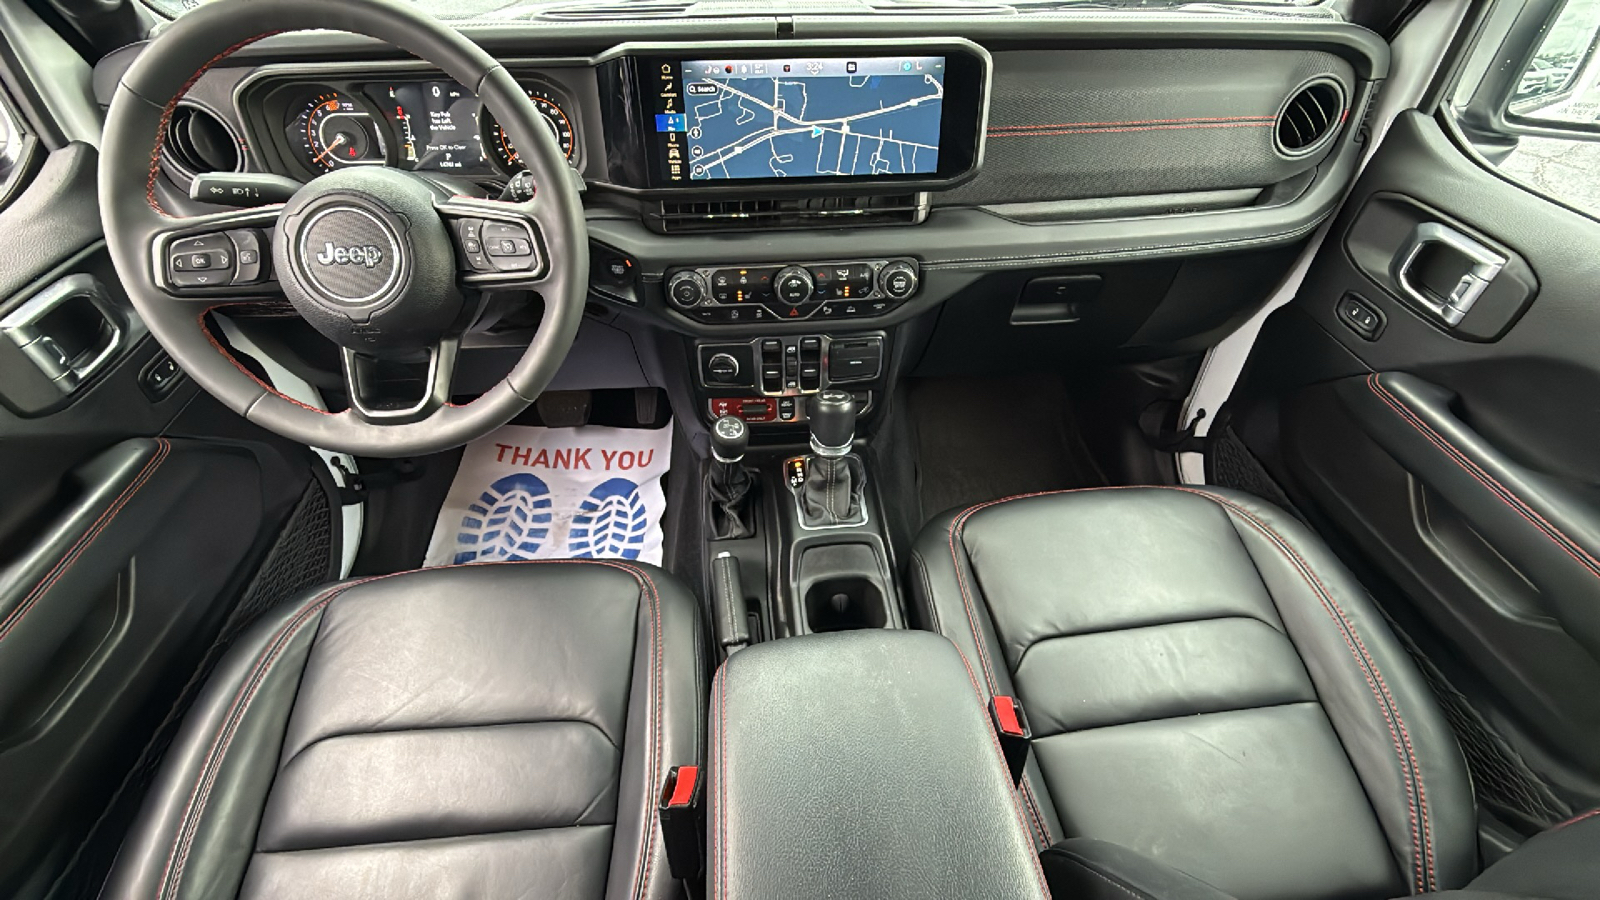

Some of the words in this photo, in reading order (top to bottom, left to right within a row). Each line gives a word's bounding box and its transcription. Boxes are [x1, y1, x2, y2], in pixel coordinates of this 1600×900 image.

[806, 62, 823, 71] 3:24
[432, 86, 440, 97] 0
[445, 152, 452, 161] P
[316, 242, 383, 268] Jeep
[495, 443, 593, 471] THANK
[600, 448, 655, 471] YOU
